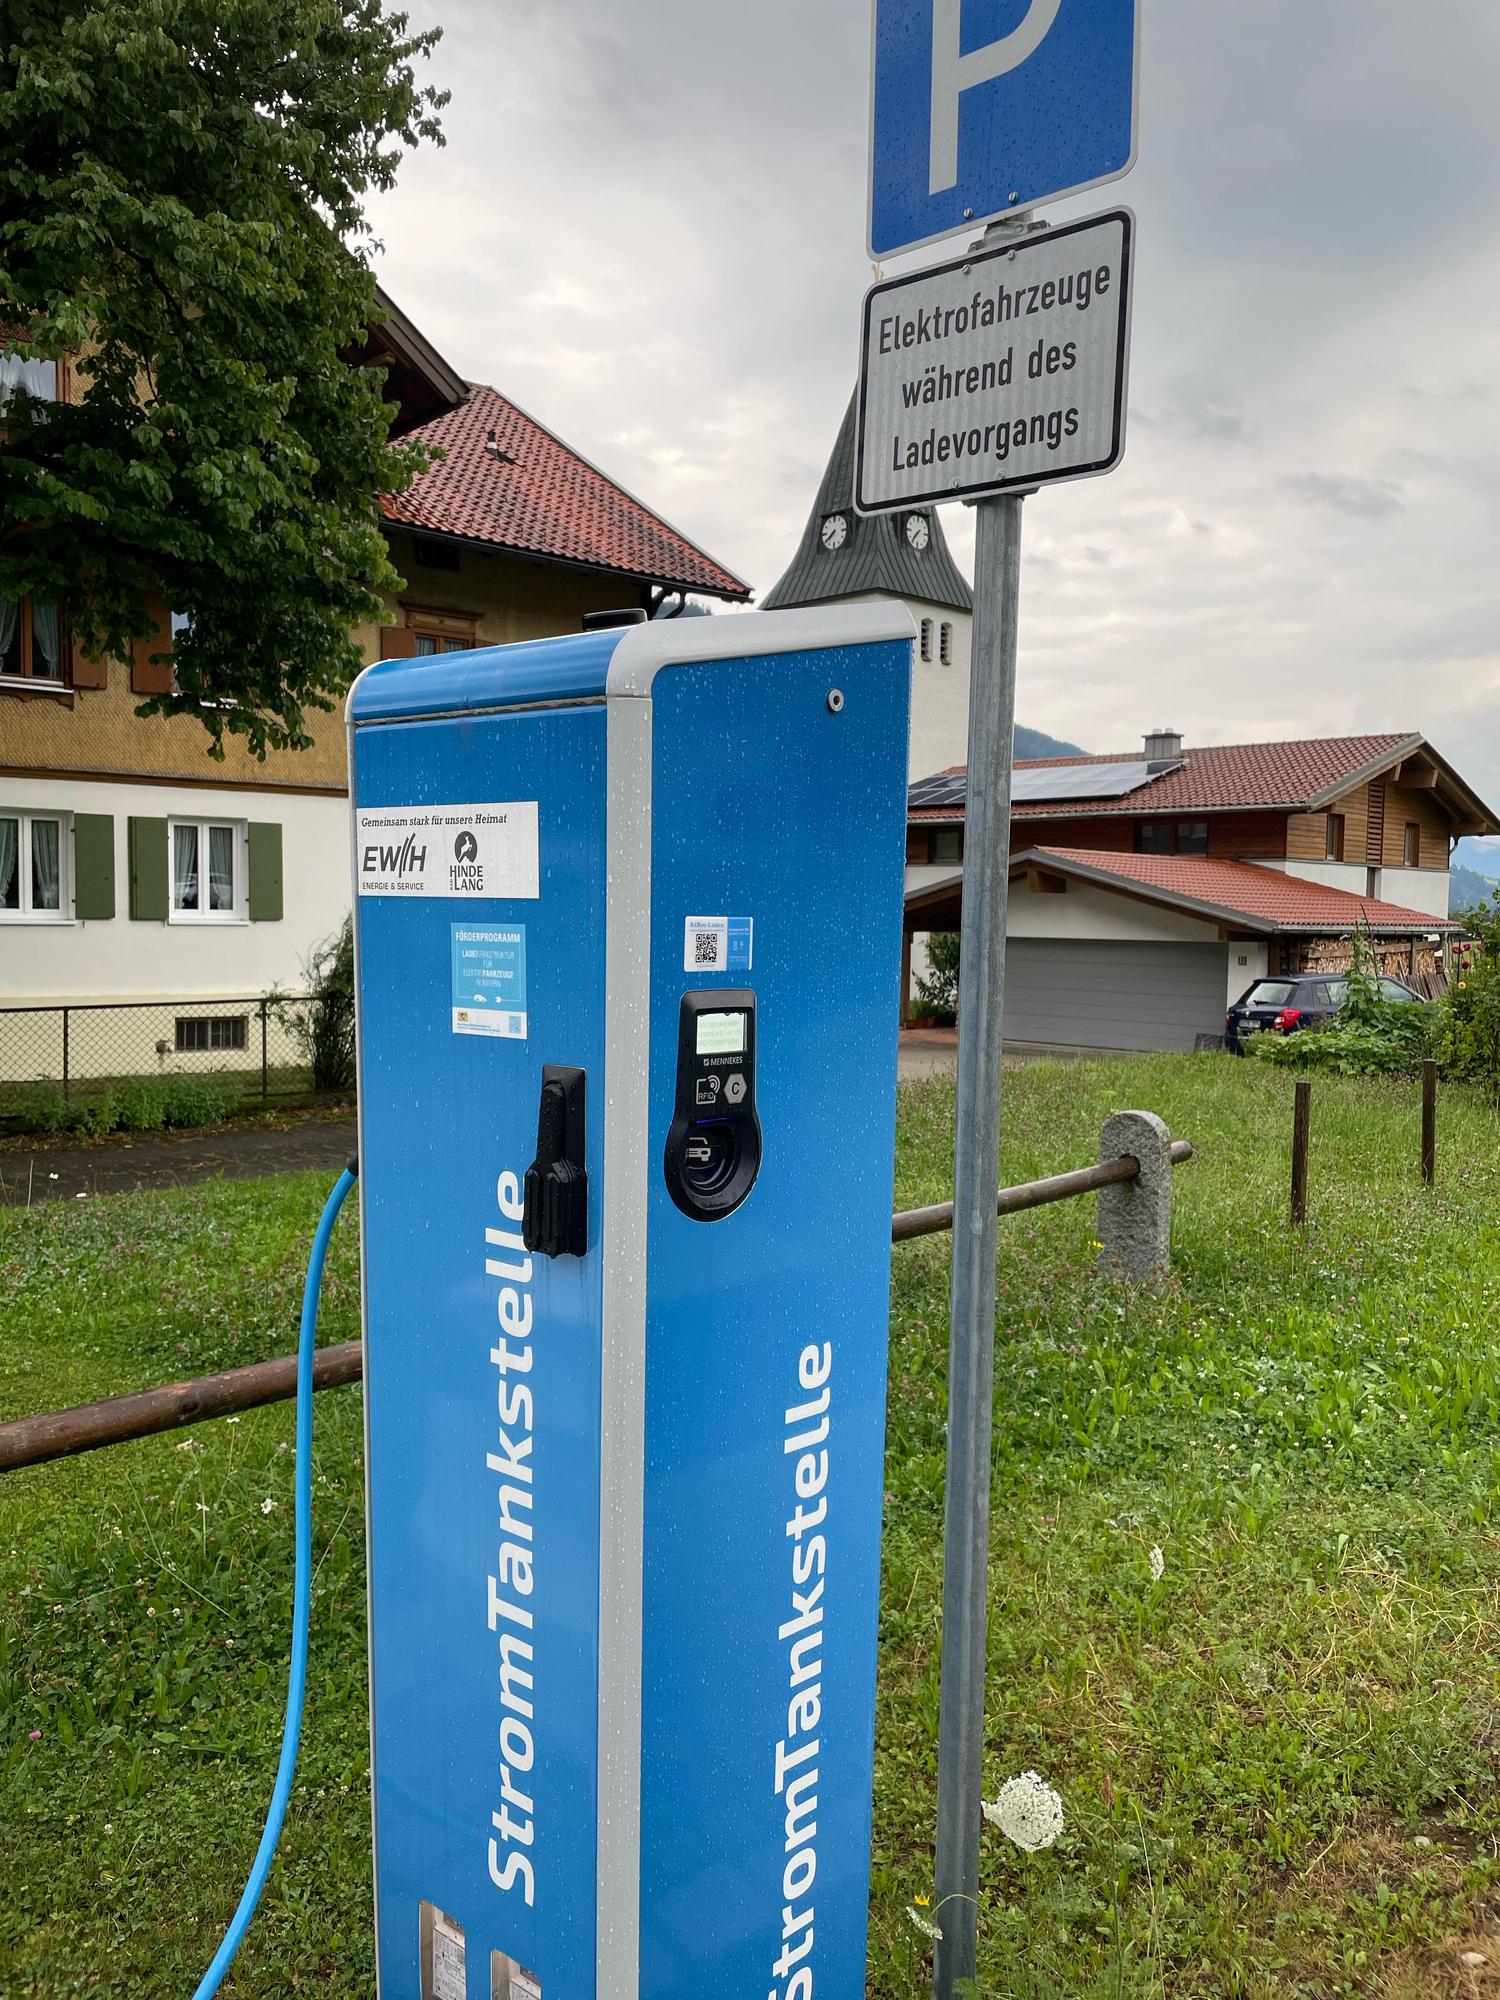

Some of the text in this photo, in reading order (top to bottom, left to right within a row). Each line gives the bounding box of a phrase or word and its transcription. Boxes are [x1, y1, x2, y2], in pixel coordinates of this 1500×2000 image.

[929, 0, 1061, 195] P
[879, 264, 1110, 354] Elektrofahrzeuge
[902, 339, 1076, 409] während des
[892, 407, 1079, 471] Ladevorgangs
[361, 814, 507, 827] Gemeinsam stark für unsere Heimat
[449, 865, 484, 878] HINDE
[362, 882, 424, 890] ENERGIE & SERVICE
[454, 878, 484, 891] LANG
[710, 1056, 743, 1066] MENNEKES
[698, 1091, 715, 1100] RFID
[485, 1170, 535, 1907] StromTankstelle
